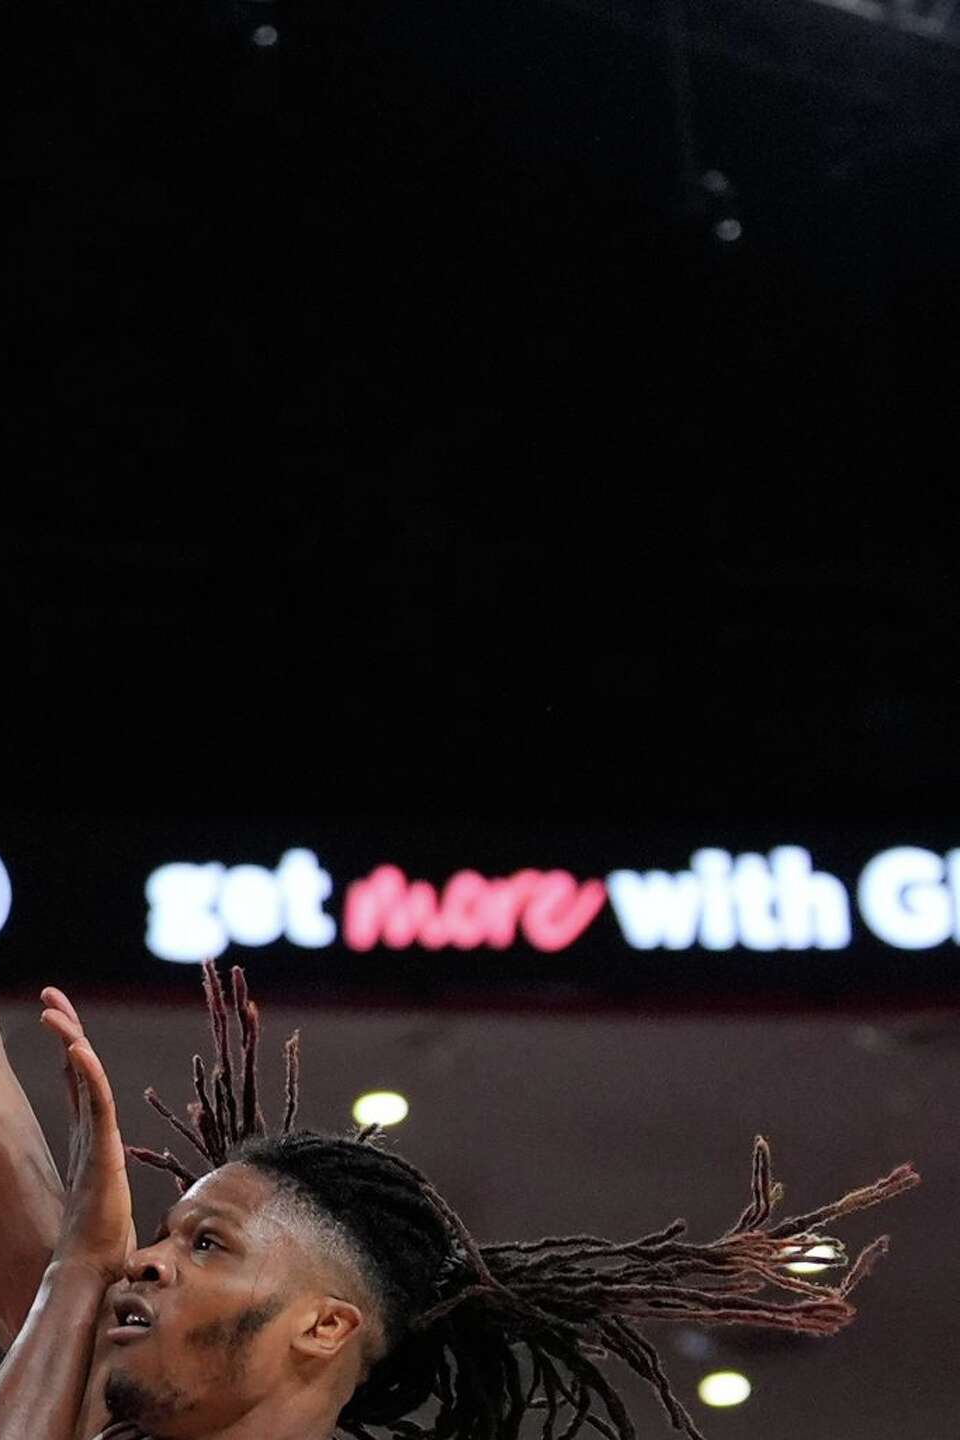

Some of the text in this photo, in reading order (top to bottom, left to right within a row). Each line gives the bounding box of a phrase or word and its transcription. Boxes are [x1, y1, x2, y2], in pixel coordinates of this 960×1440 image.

[146, 846, 960, 962] get more with G
